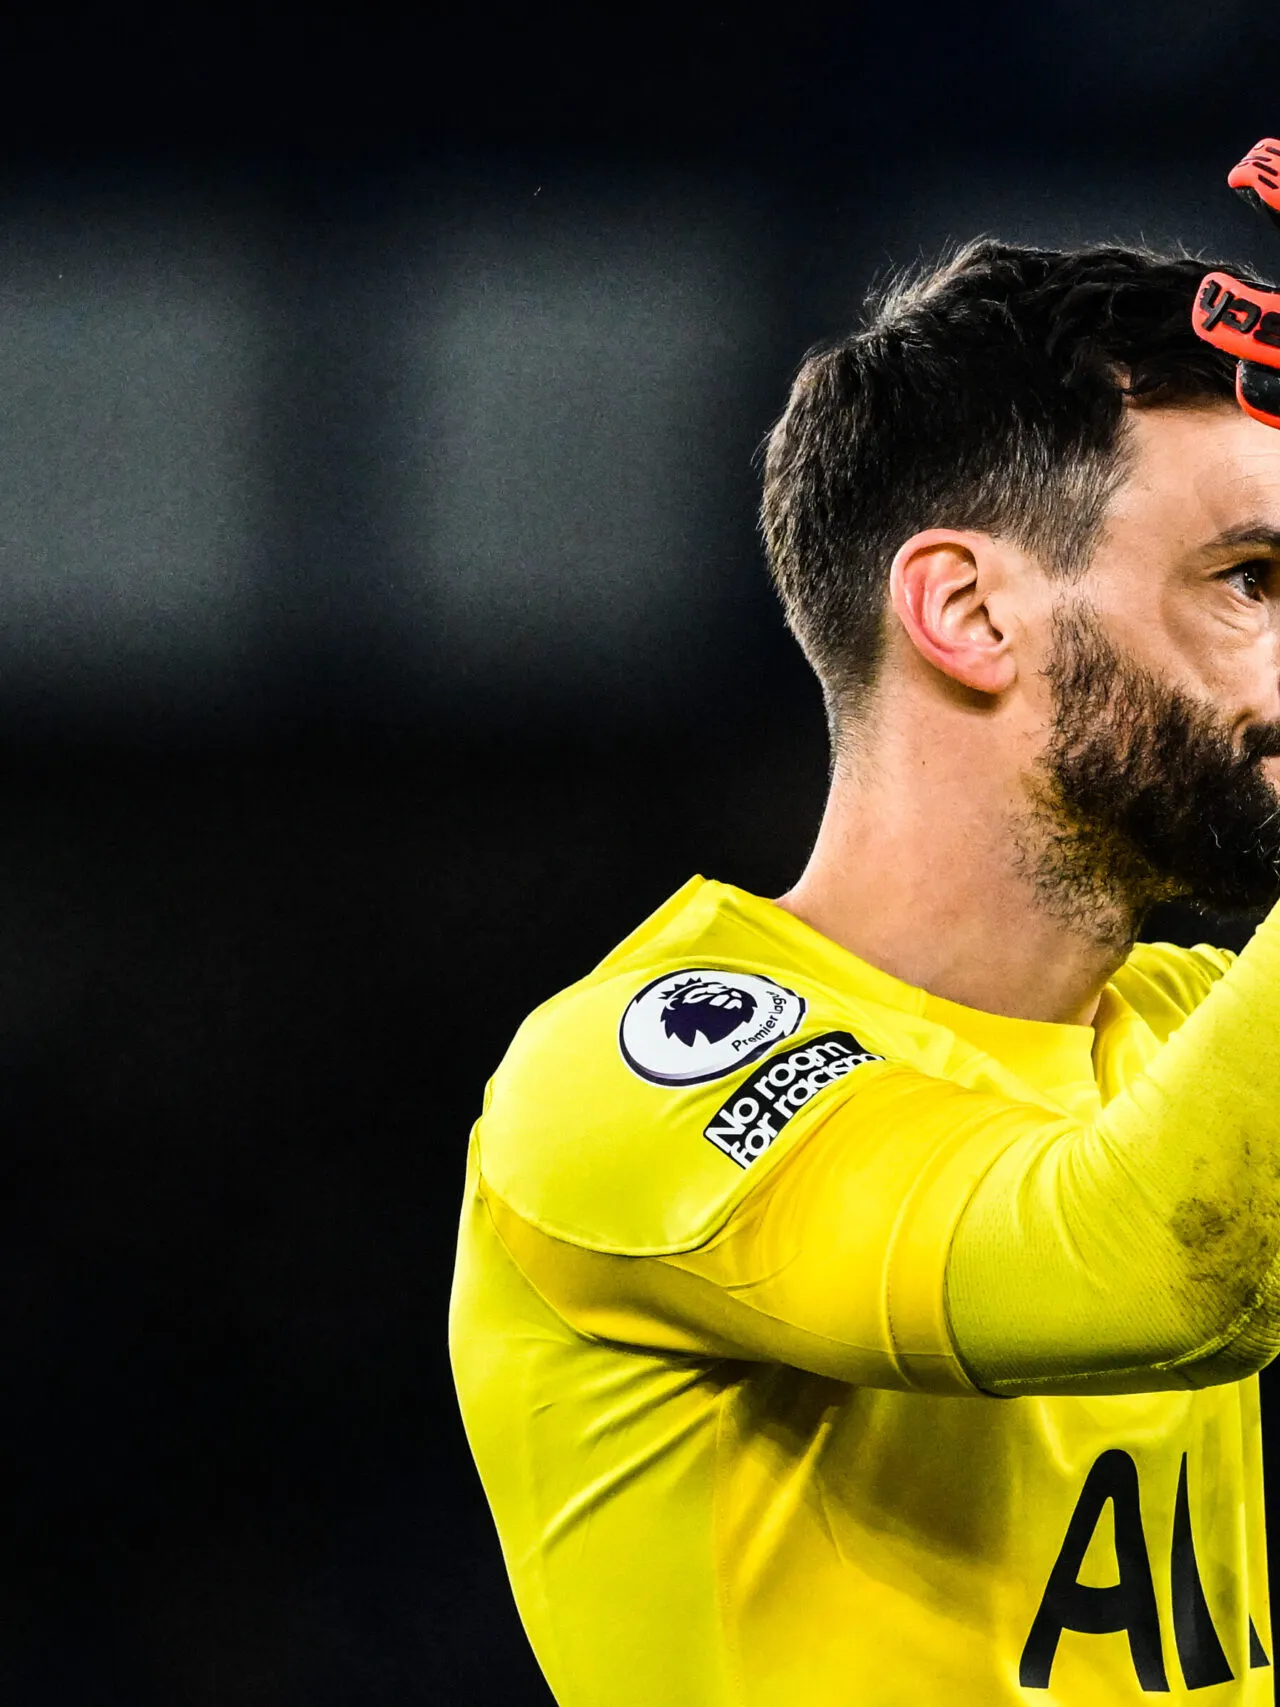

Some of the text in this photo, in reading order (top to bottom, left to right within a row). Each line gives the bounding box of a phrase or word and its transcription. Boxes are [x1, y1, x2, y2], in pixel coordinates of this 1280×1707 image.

[731, 1015, 778, 1051] Premier
[705, 1041, 853, 1153] No room
[730, 1112, 778, 1167] for
